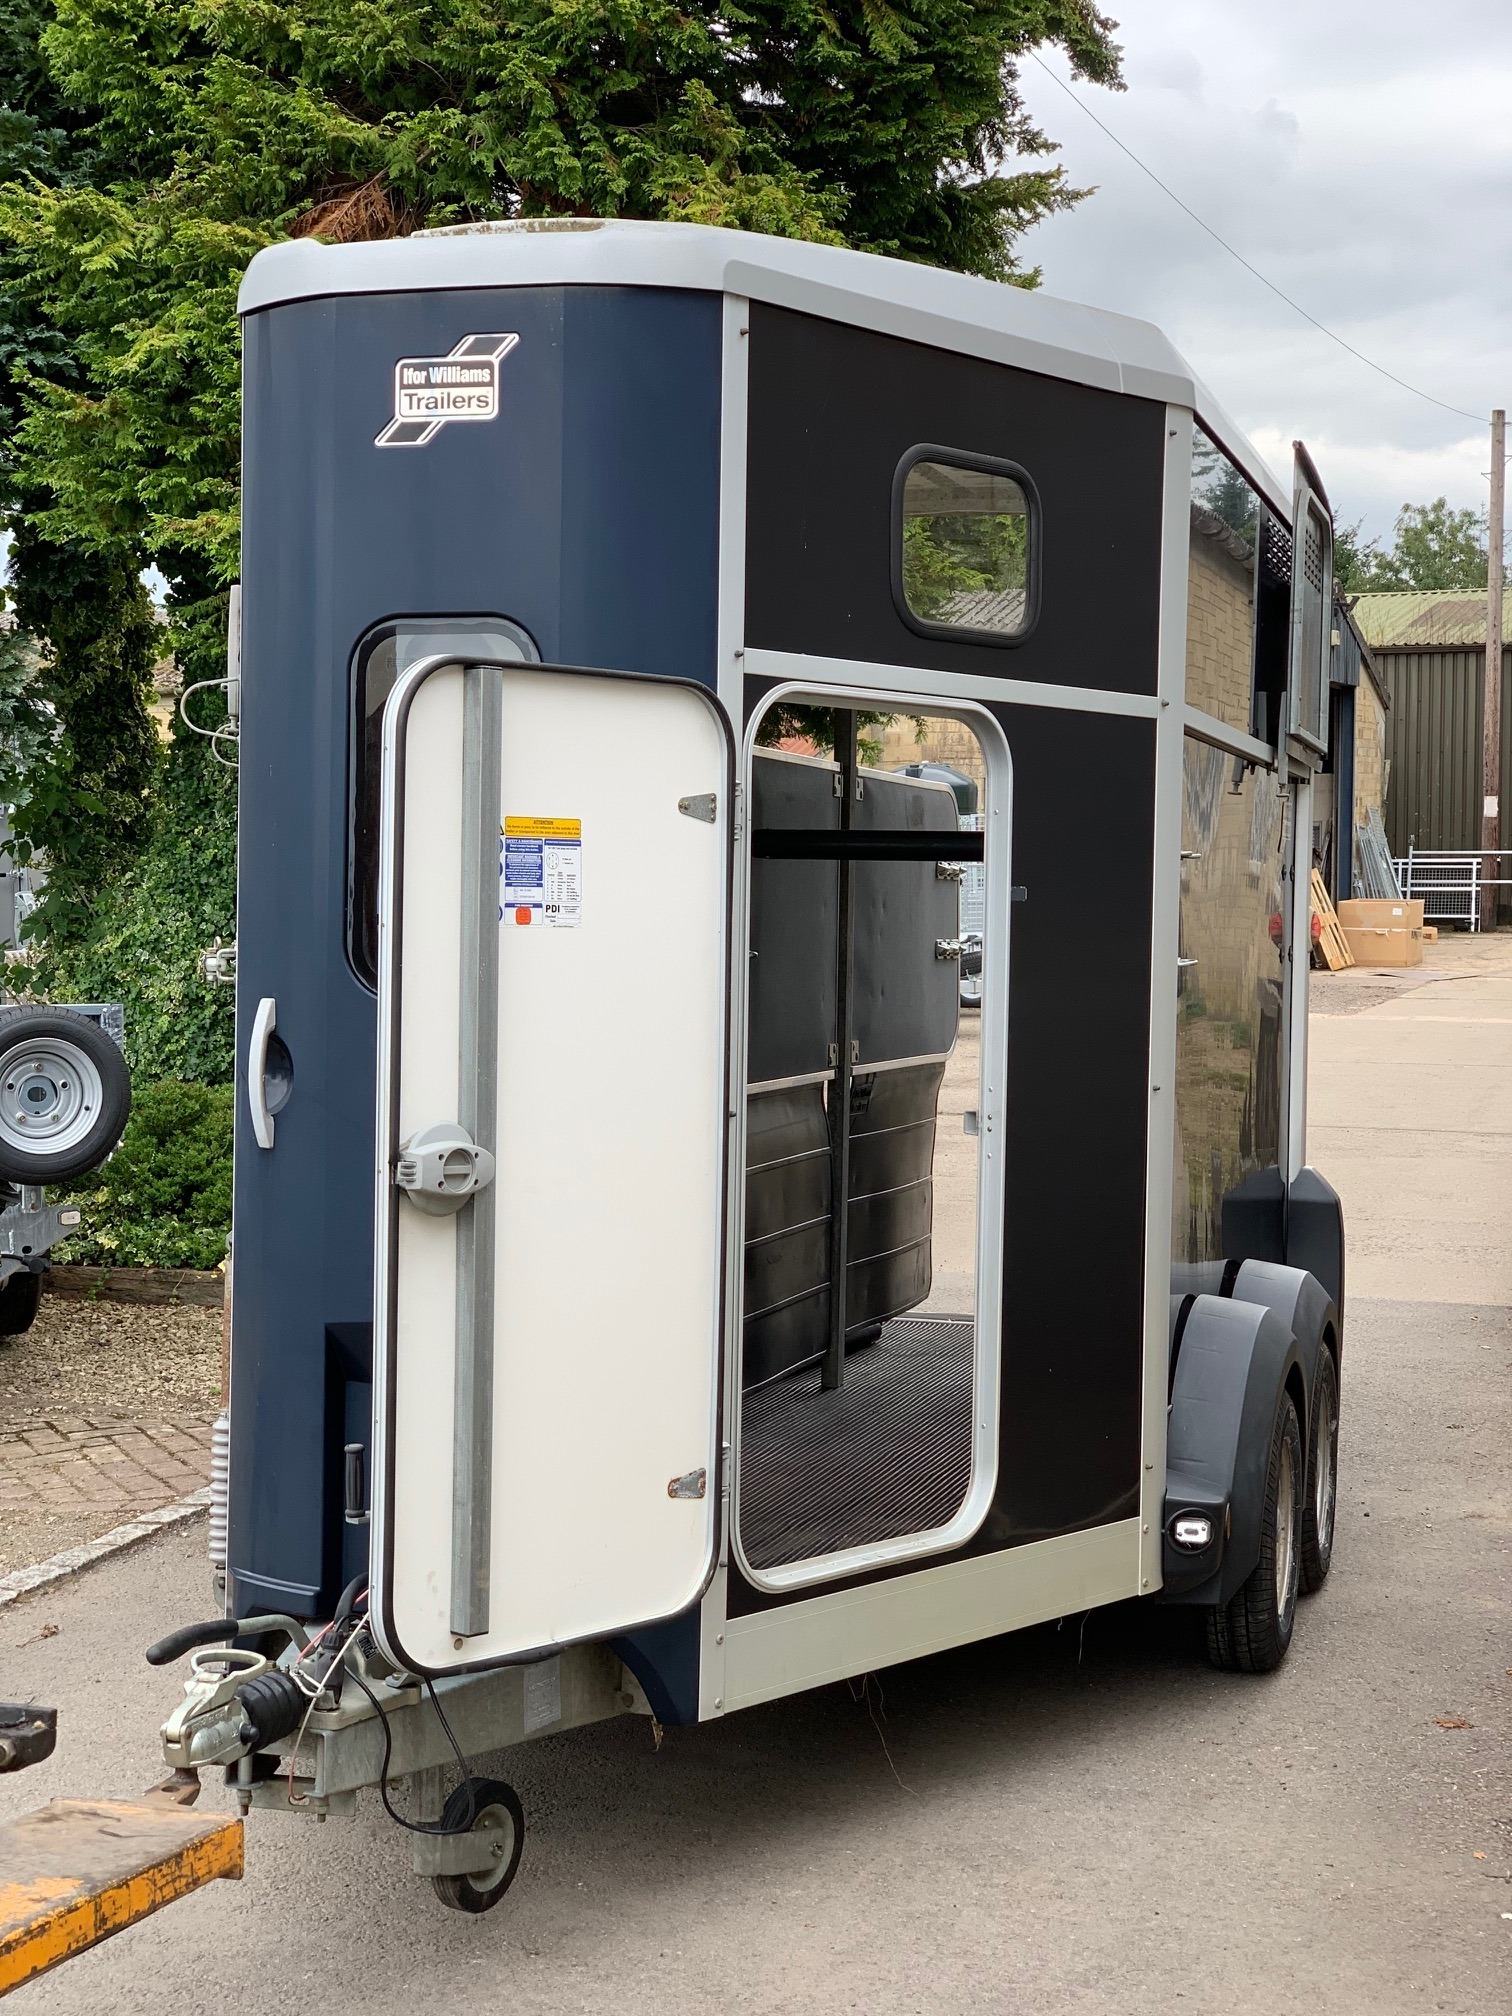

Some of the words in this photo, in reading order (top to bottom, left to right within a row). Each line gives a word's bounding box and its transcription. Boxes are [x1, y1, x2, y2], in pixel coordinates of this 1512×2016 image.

[402, 367, 427, 385] Ifor
[429, 365, 491, 384] Williams
[403, 391, 490, 411] Trailers
[545, 904, 560, 913] PDI
